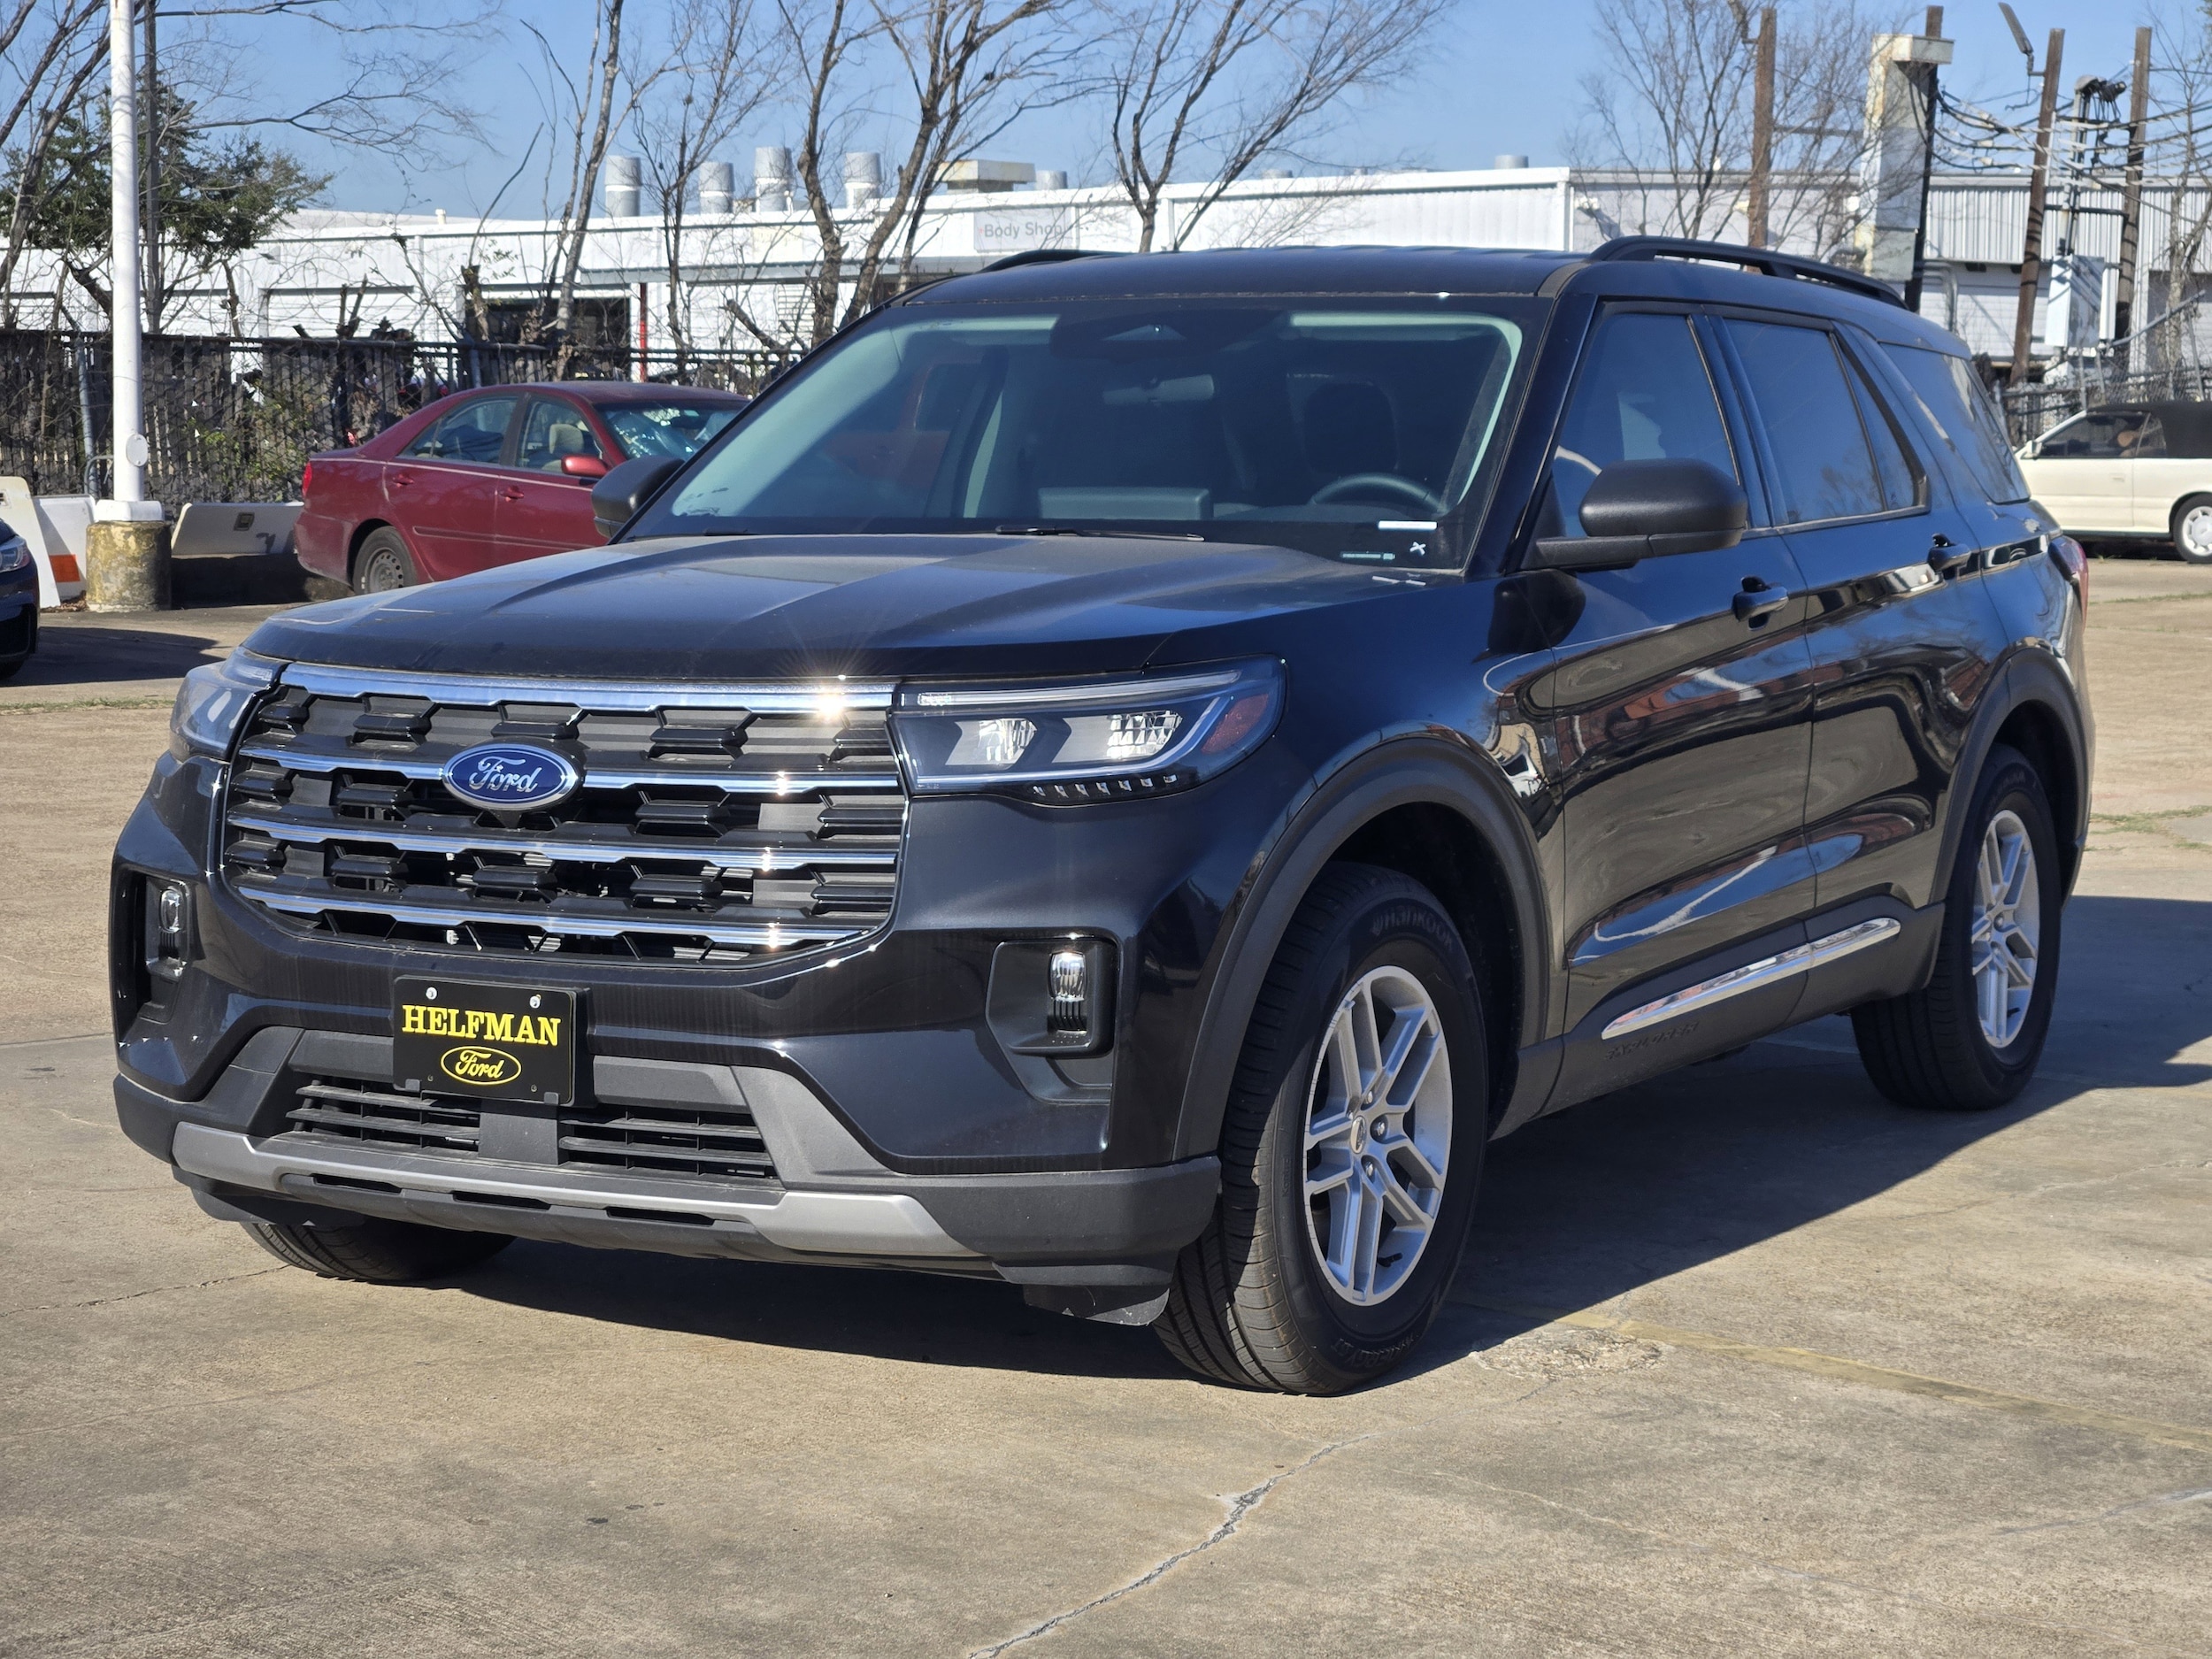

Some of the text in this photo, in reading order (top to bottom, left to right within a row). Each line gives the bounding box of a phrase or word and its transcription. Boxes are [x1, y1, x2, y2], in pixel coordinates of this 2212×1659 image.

[984, 221, 1063, 239] Body Shop
[468, 756, 542, 793] Ford
[402, 1004, 562, 1046] HELFMAN
[455, 1049, 505, 1079] Ford
